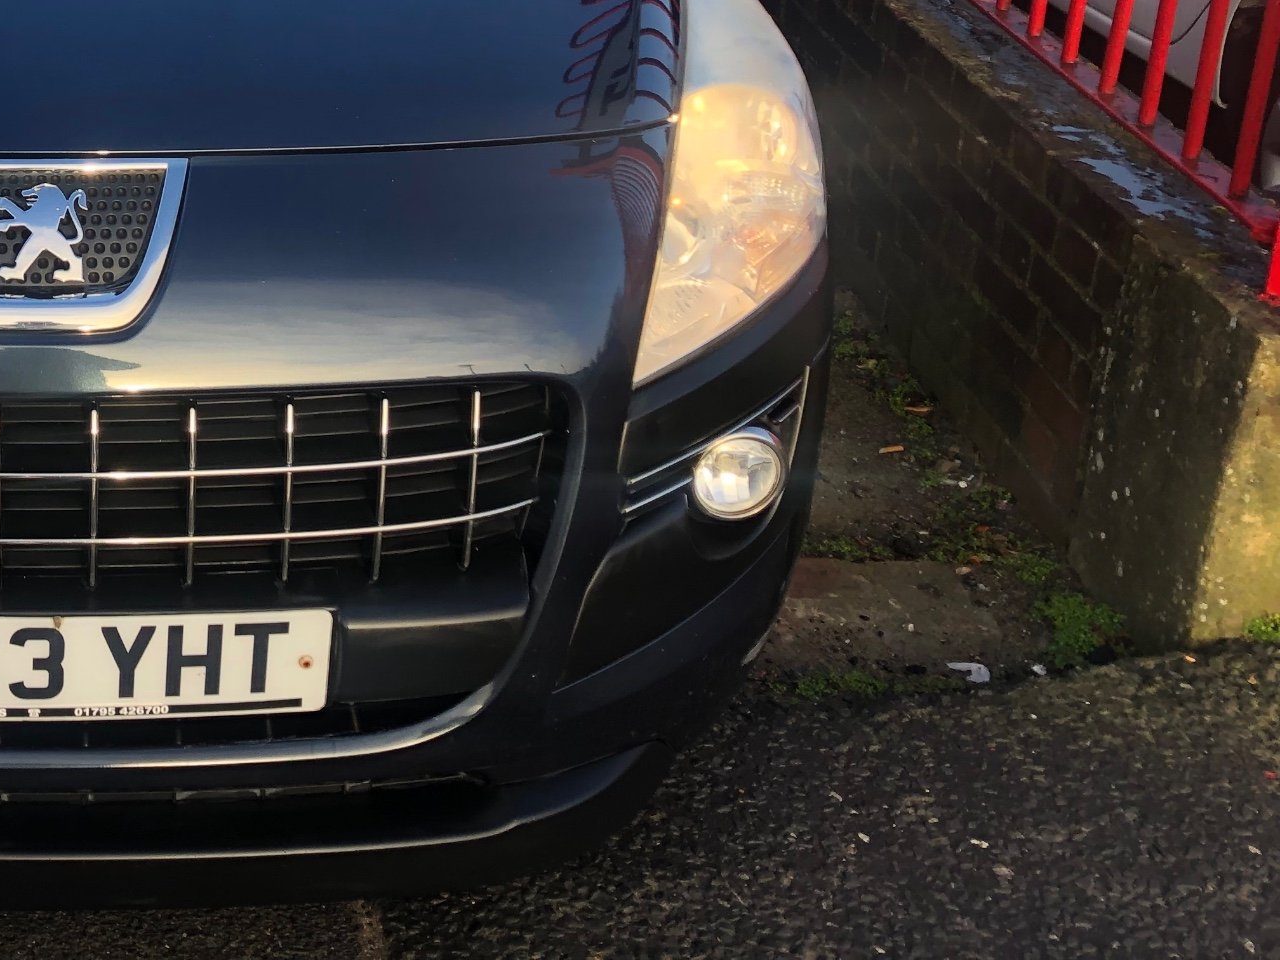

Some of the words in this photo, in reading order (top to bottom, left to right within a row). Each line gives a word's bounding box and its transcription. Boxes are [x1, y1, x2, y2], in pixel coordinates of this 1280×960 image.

[101, 621, 290, 699] YHT
[74, 706, 116, 716] 01795
[119, 705, 169, 715] 426700
